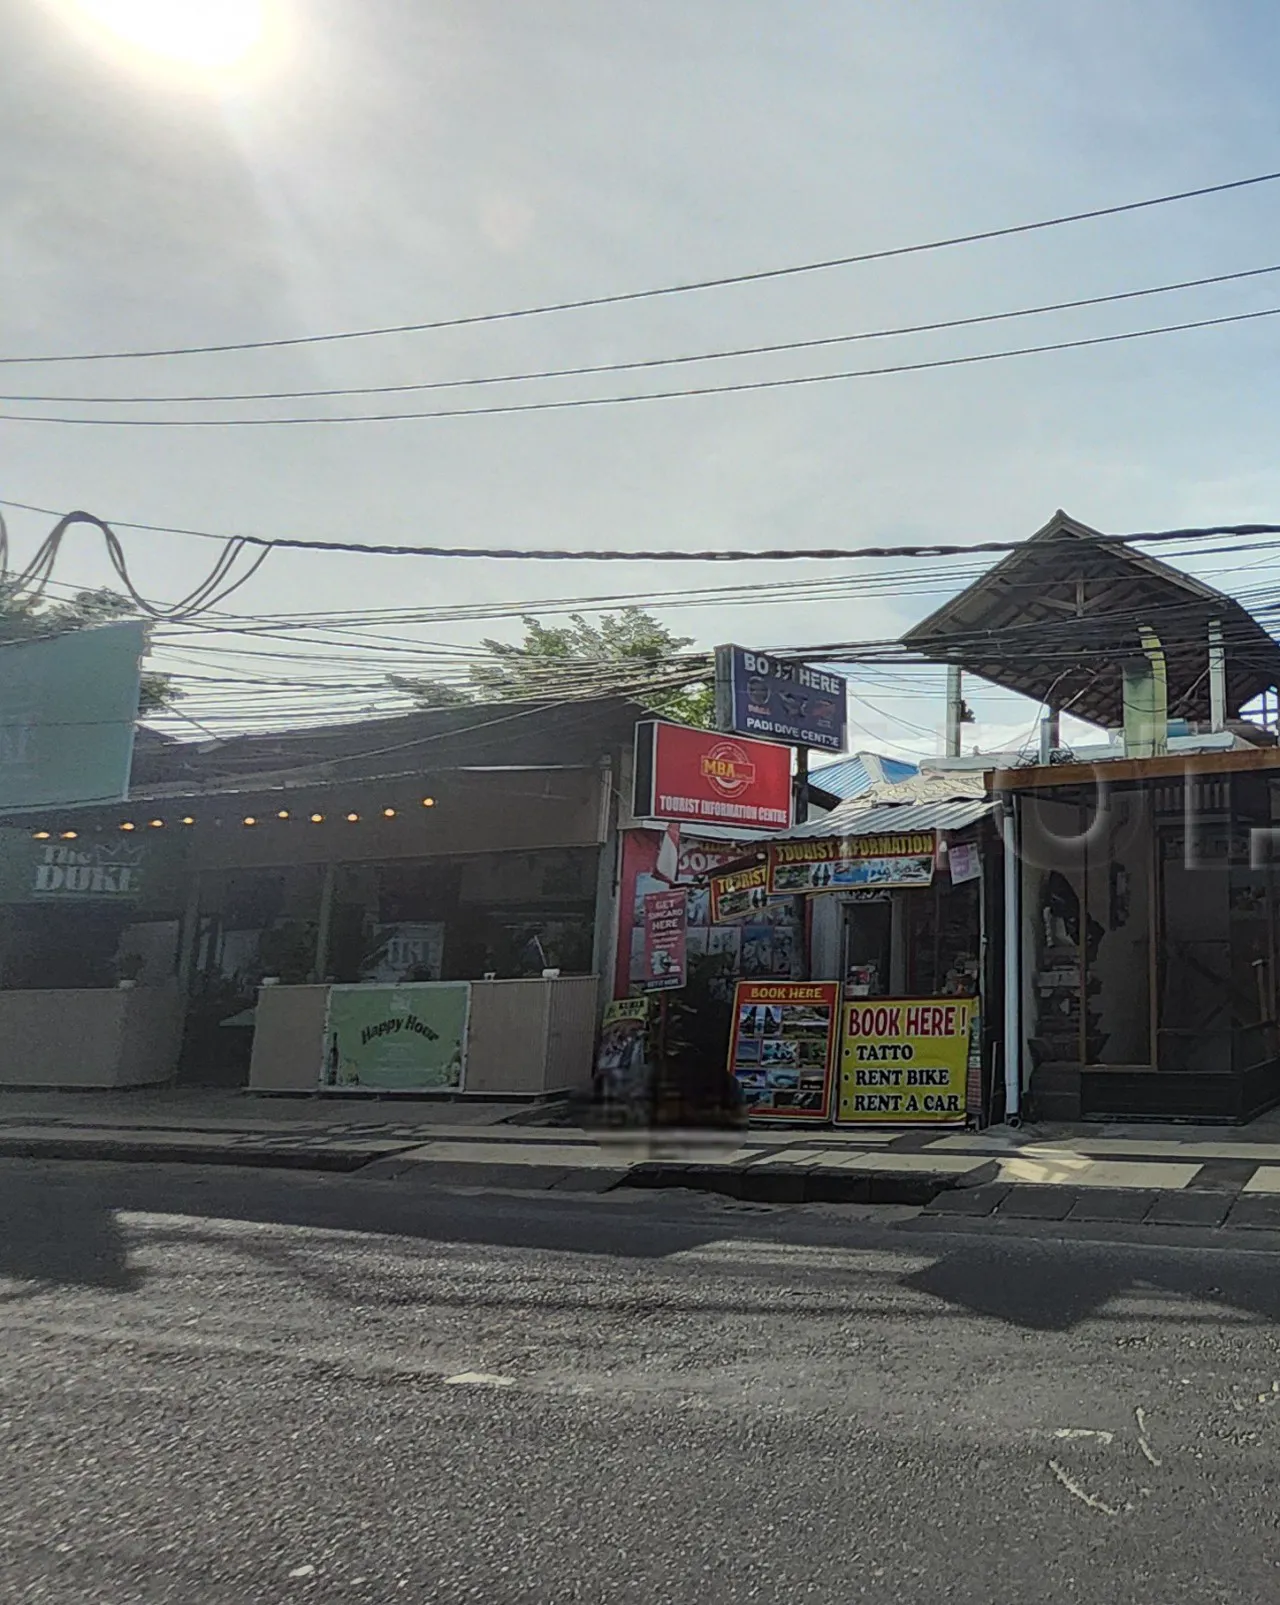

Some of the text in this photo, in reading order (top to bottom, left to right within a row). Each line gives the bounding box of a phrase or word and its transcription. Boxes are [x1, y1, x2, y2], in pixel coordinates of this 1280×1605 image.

[799, 668, 841, 696] HERE
[746, 717, 773, 732] PADI
[775, 723, 799, 739] DIVE
[702, 759, 735, 777] MBA
[660, 796, 787, 824] TOURIST INFORMATION CENTRE
[39, 844, 93, 865] The
[776, 841, 834, 862] TOURIST
[655, 899, 675, 910] GET
[652, 918, 679, 931] HERE
[751, 987, 823, 999] BOOK HERE
[361, 1014, 439, 1045] Happy Hour
[847, 1007, 901, 1036] BOOK
[906, 1006, 956, 1036] HERE
[856, 1044, 914, 1061] TATTO
[855, 1069, 950, 1086] RENT BIKE
[854, 1095, 960, 1112] RENT A CAR
